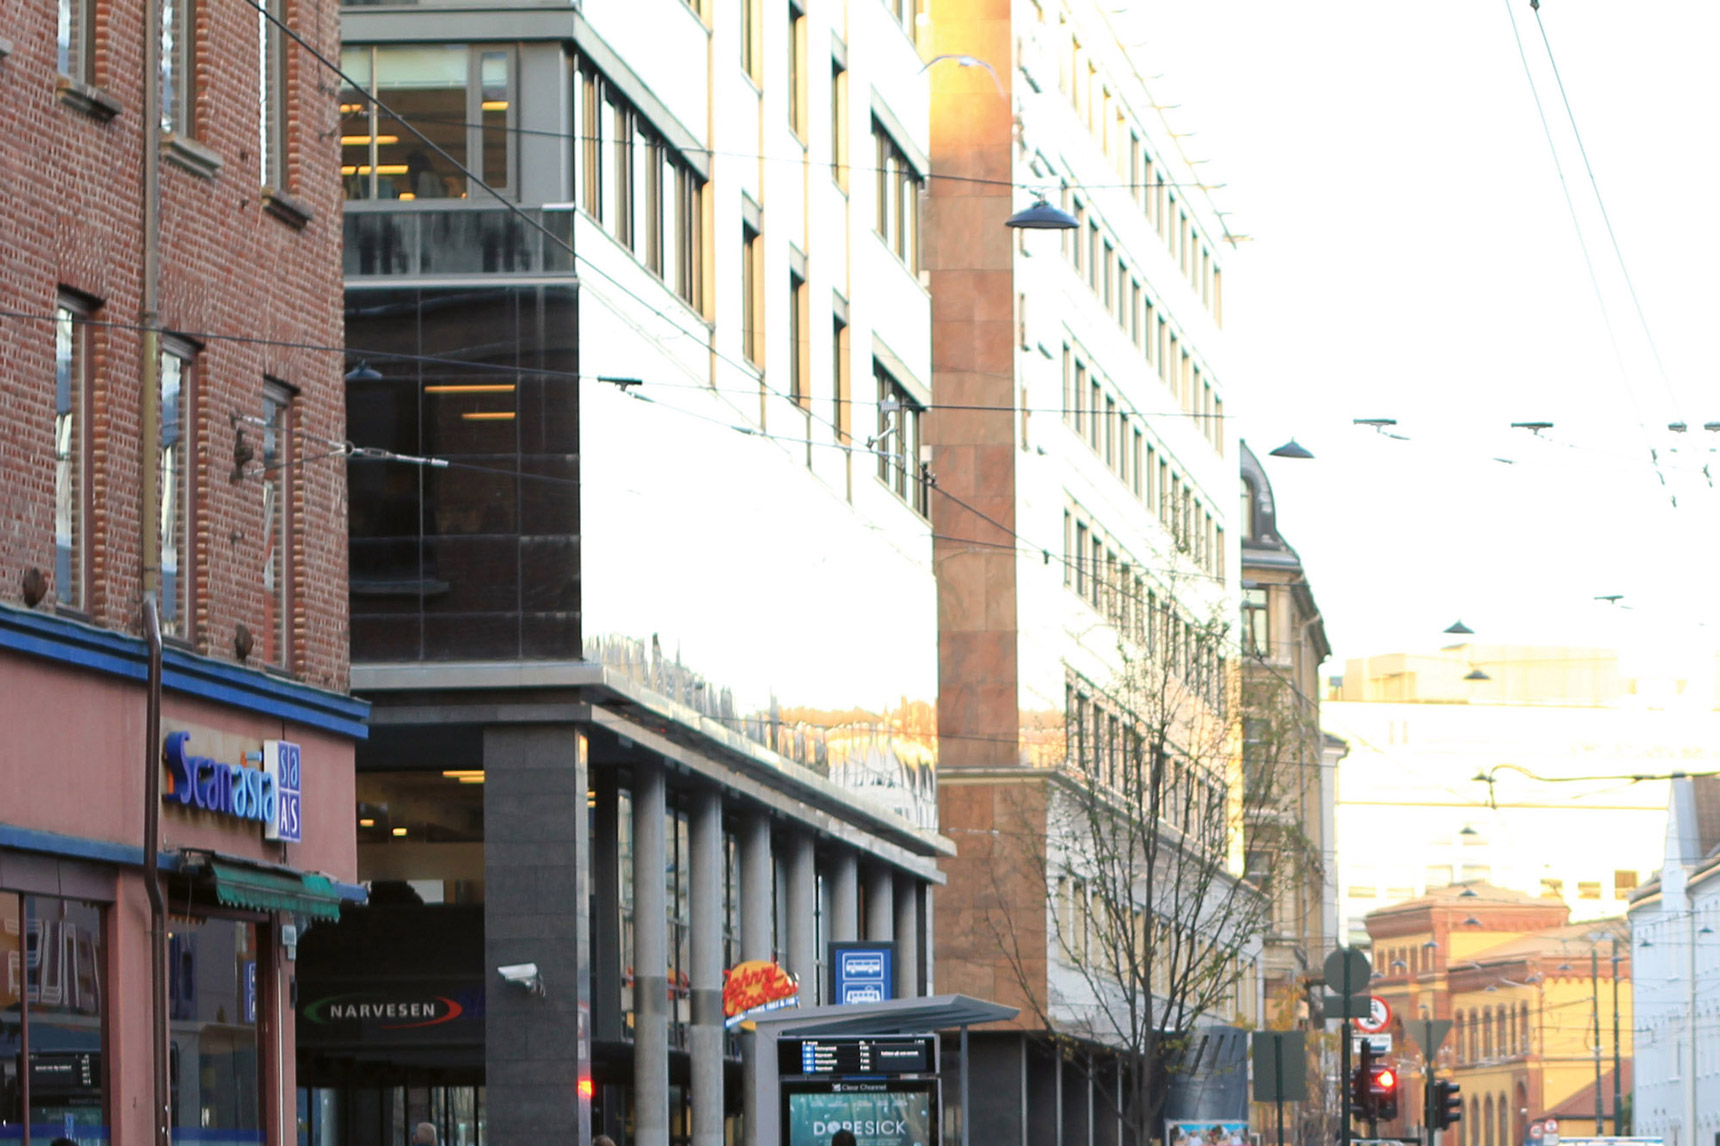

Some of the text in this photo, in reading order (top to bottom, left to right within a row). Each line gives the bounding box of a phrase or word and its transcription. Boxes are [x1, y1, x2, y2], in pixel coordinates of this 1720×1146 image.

[170, 731, 275, 824] Scanasia
[330, 1003, 435, 1018] NARVESEN
[859, 1083, 887, 1091] Channel
[813, 1120, 906, 1136] DOPESICK
